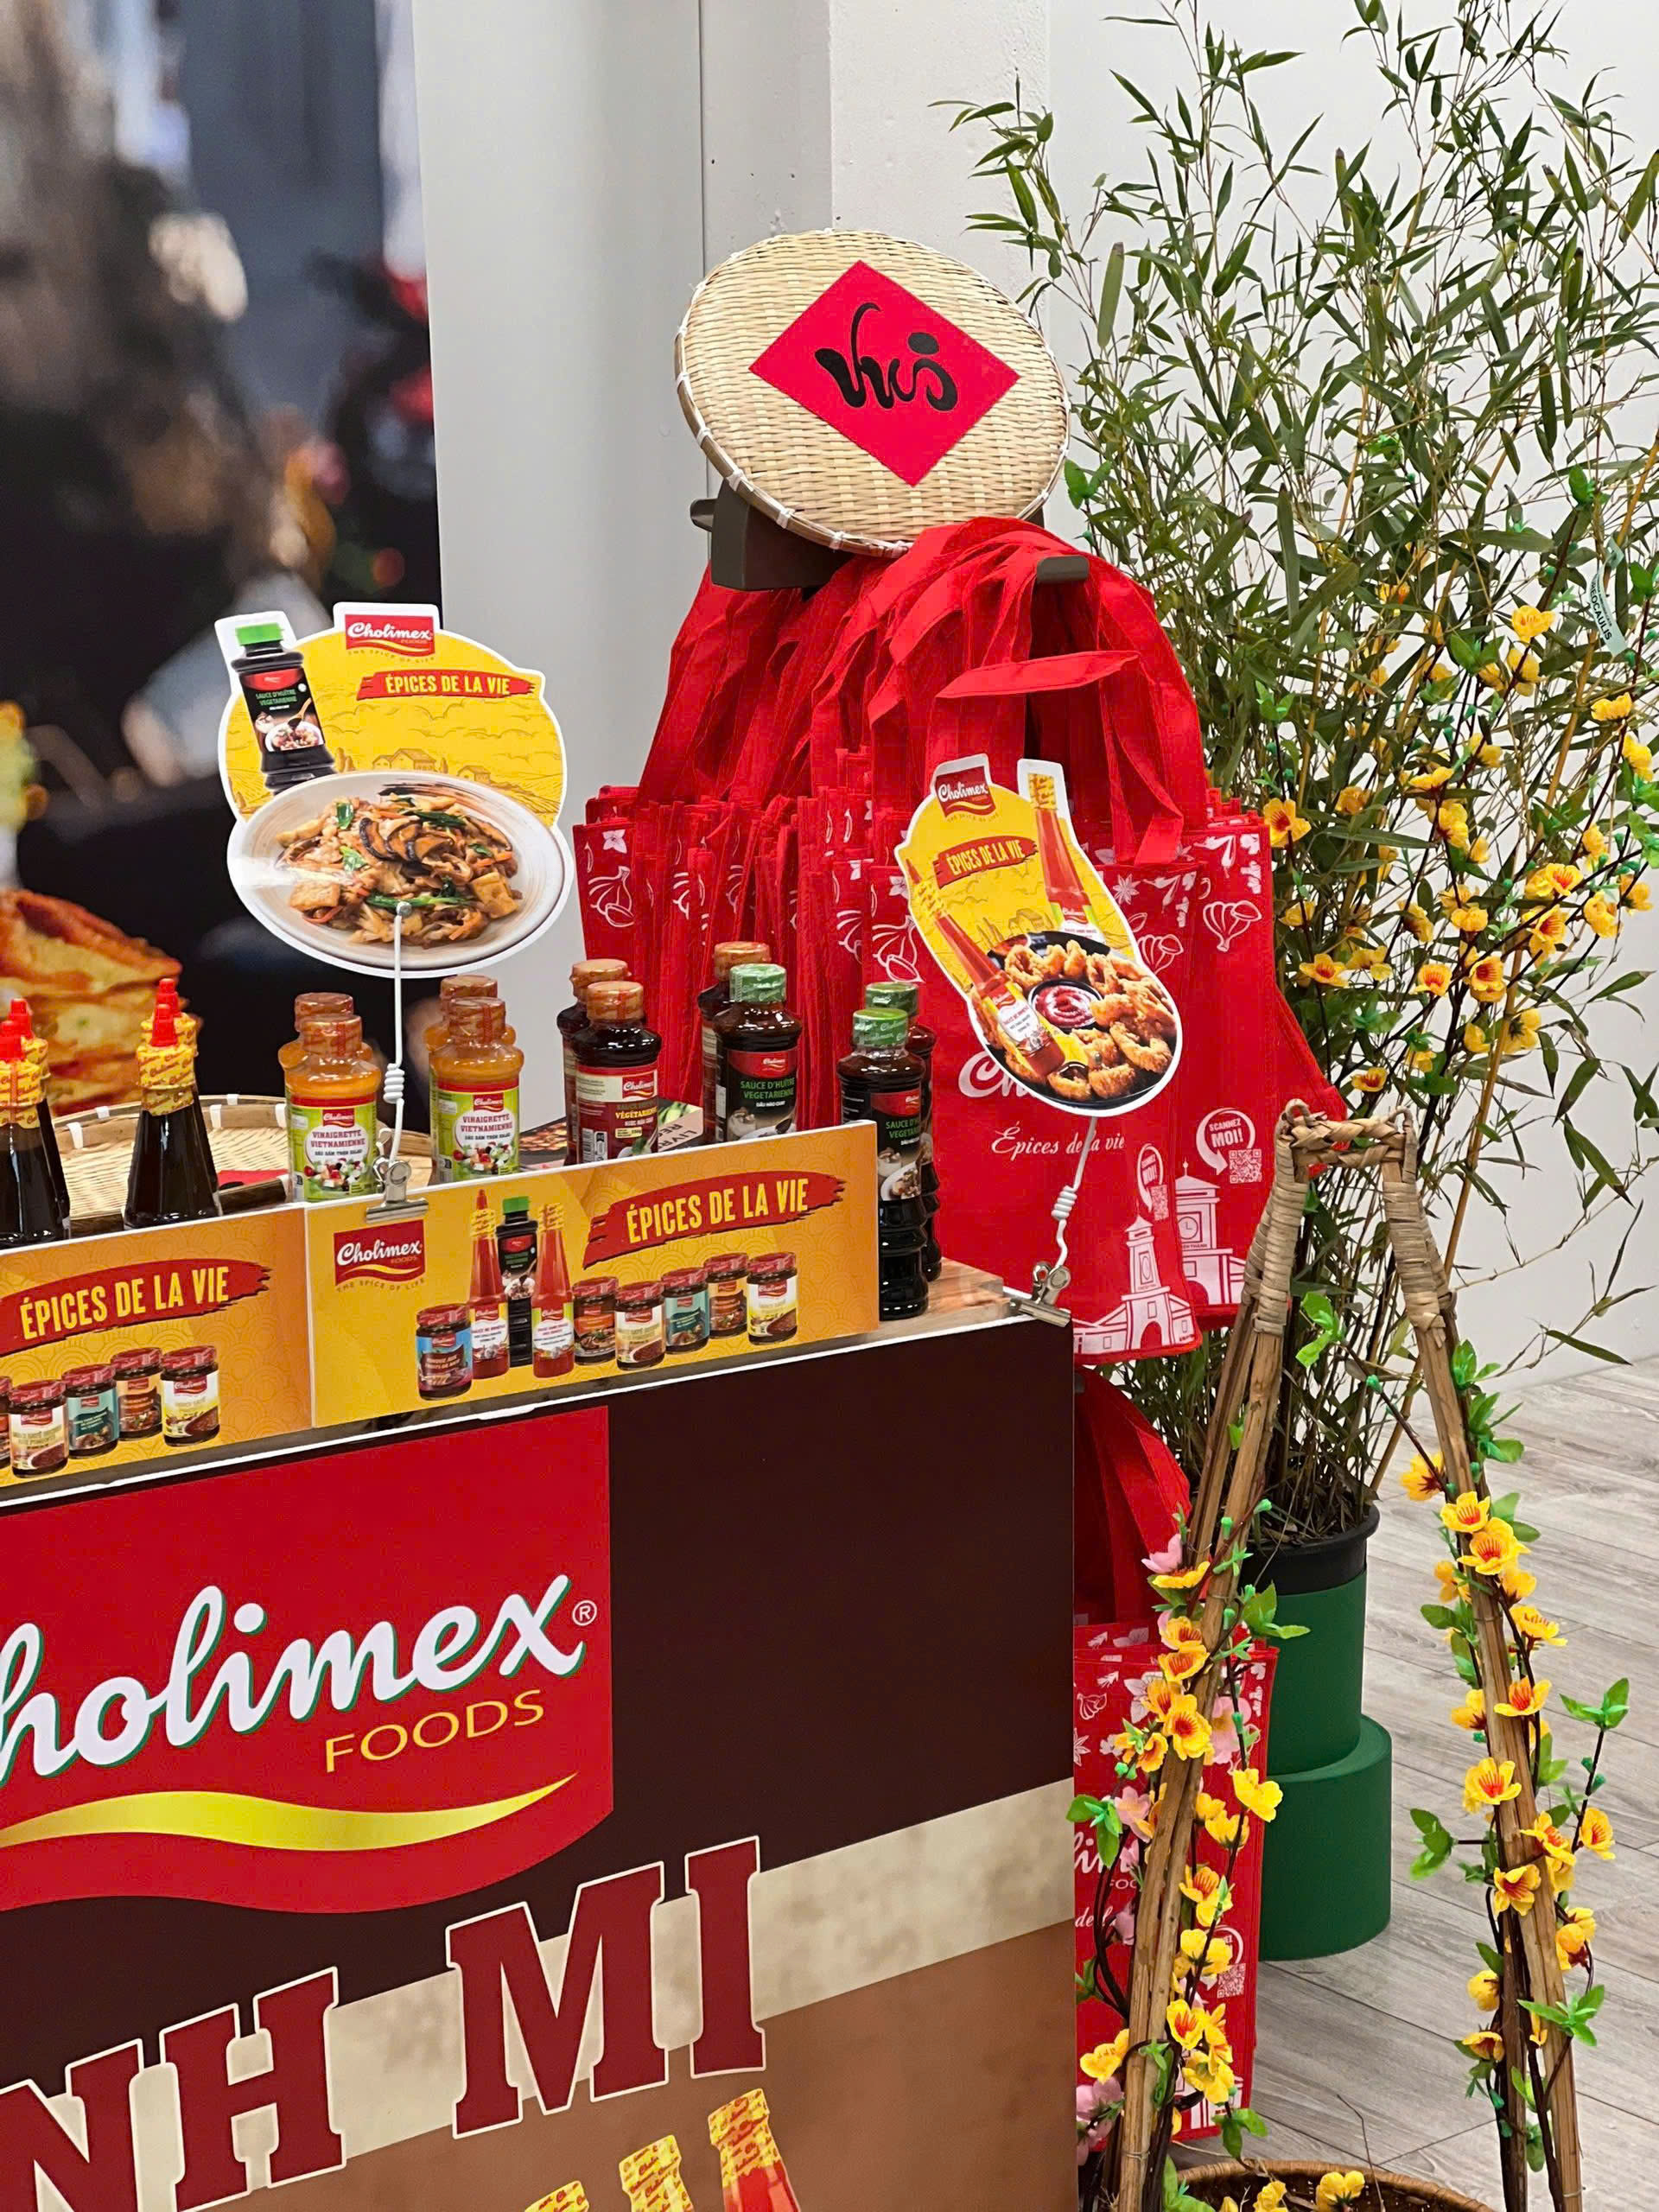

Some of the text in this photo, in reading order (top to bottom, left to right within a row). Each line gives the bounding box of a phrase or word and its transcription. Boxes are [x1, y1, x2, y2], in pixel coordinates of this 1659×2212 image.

[347, 621, 432, 641] Cholimex
[385, 674, 511, 695] ÉPICES DE LA VIE
[938, 781, 988, 803] Cholimex
[946, 839, 1025, 875] ÉPICES DE LA VIE
[740, 1080, 766, 1090] SAUCE
[462, 1113, 510, 1123] VINAIGRETTE
[886, 1119, 909, 1129] SAUCE
[1209, 1117, 1242, 1132] SCANNEZ
[310, 1138, 365, 1147] VIETNAMIENNE
[312, 1129, 362, 1139] VINAIGRETTE
[991, 1121, 1059, 1161] Épices
[1065, 1132, 1083, 1154] de
[1105, 1133, 1125, 1150] vie
[1211, 1128, 1244, 1148] MOI!
[626, 1178, 809, 1244] ÉPICES DE LA VIE
[336, 1238, 422, 1266] Cholimex
[20, 1267, 229, 1340] ÉPICES DE LA VIE
[0, 1574, 584, 1785] holimex
[326, 1689, 544, 1773] FOODS
[0, 1967, 346, 2212] NH
